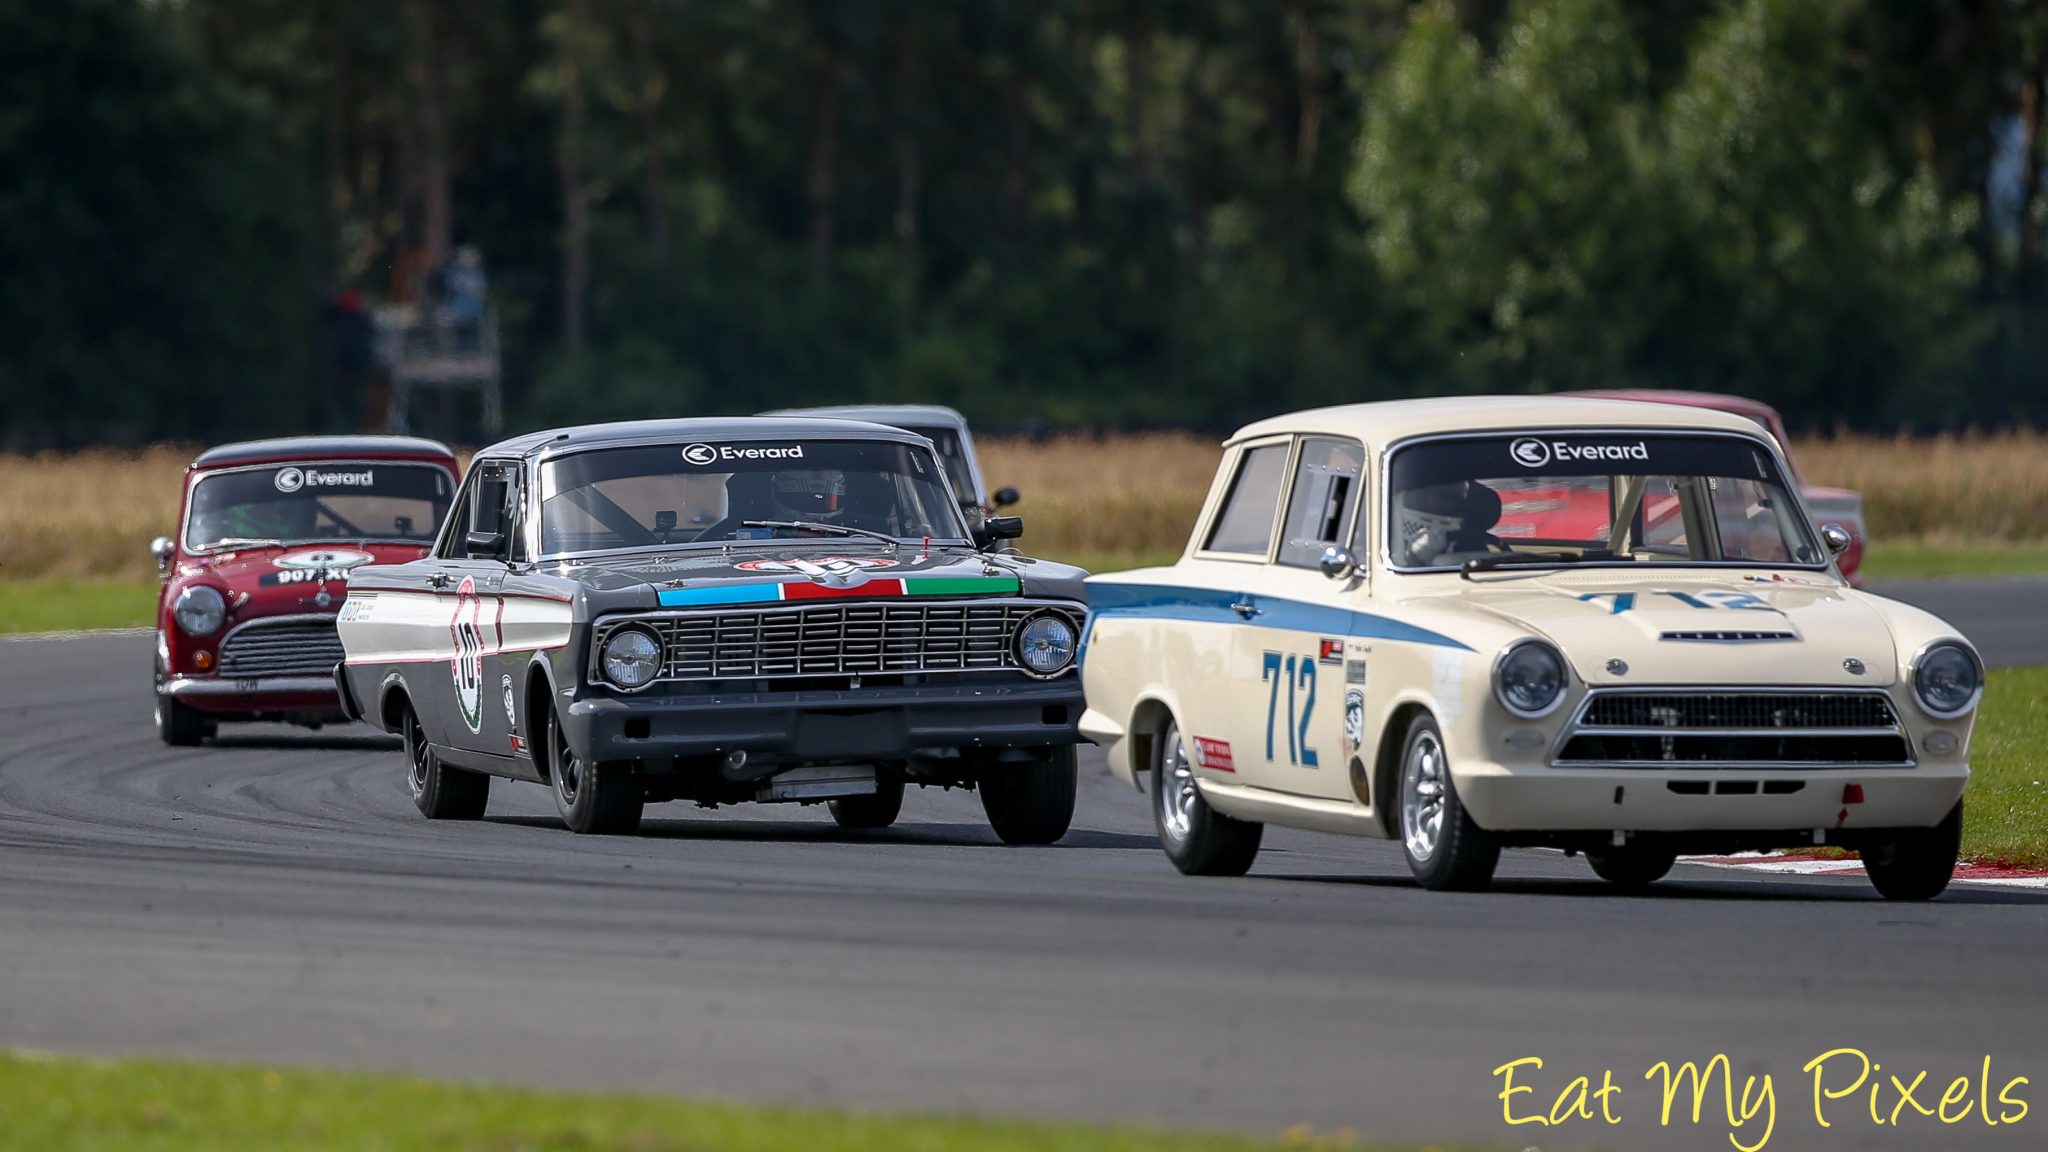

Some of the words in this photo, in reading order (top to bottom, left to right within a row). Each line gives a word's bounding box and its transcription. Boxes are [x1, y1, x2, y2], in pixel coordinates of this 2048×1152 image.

[721, 446, 803, 460] Everard
[1551, 442, 1649, 461] Everard
[305, 469, 374, 486] Everard
[277, 568, 317, 584] 907
[457, 622, 478, 690] 10
[1261, 648, 1319, 769] 712
